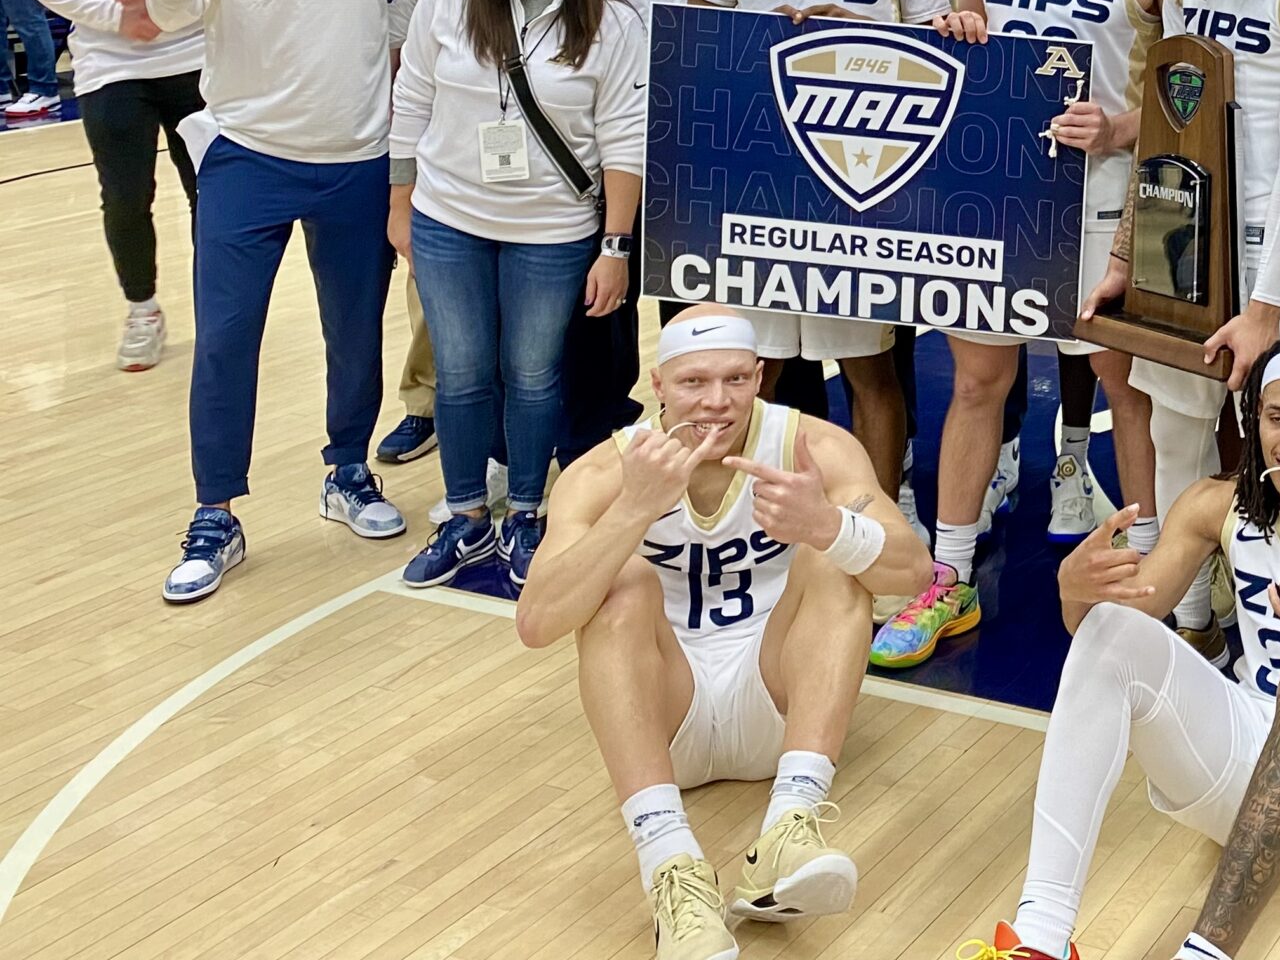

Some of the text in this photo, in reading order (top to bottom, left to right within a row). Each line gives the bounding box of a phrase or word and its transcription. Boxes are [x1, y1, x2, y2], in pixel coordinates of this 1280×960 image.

[1183, 8, 1271, 54] ZIPS
[844, 56, 891, 74] 1946
[1035, 46, 1085, 78] A
[792, 84, 945, 135] MAC
[1139, 182, 1194, 208] CHAMPION
[729, 222, 996, 271] REGULAR SEASON
[670, 253, 1049, 337] CHAMPIONS
[642, 530, 789, 573] ZIPS
[688, 569, 754, 629] 13
